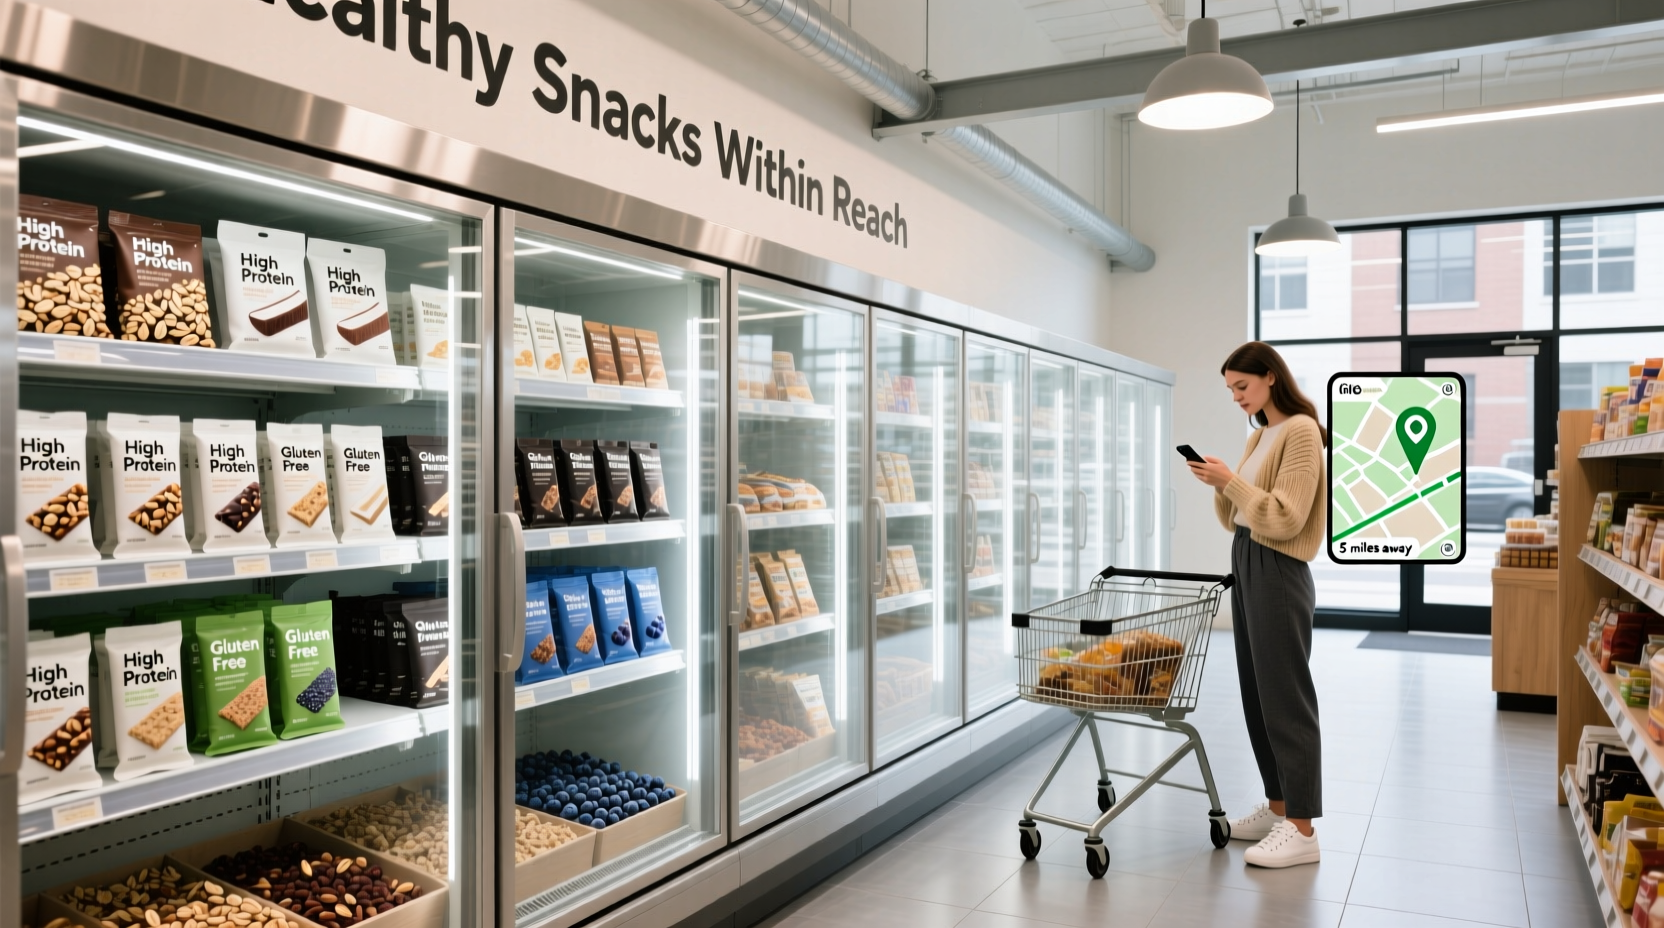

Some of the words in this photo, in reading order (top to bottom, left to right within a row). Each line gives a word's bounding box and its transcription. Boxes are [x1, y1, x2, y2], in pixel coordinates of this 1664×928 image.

[258, 0, 514, 107] althy
[531, 42, 703, 167] Snacks
[713, 121, 824, 216] Within
[832, 176, 908, 249] Reach
[18, 216, 64, 239] High
[18, 233, 85, 257] Protein
[132, 237, 173, 256] High
[134, 252, 192, 272] Protein
[241, 253, 278, 272] High
[328, 266, 360, 285] High
[21, 438, 65, 456] High
[125, 440, 164, 458] High
[210, 444, 244, 460] High
[281, 446, 322, 459] Gluten
[343, 448, 380, 460] Gluten
[20, 456, 81, 471] Protein
[123, 457, 177, 471] Protein
[345, 461, 371, 472] Free
[286, 629, 329, 643] Gluten
[210, 639, 259, 654] Gluten
[124, 650, 163, 669] High
[213, 657, 246, 671] Free
[123, 667, 177, 686] Protein
